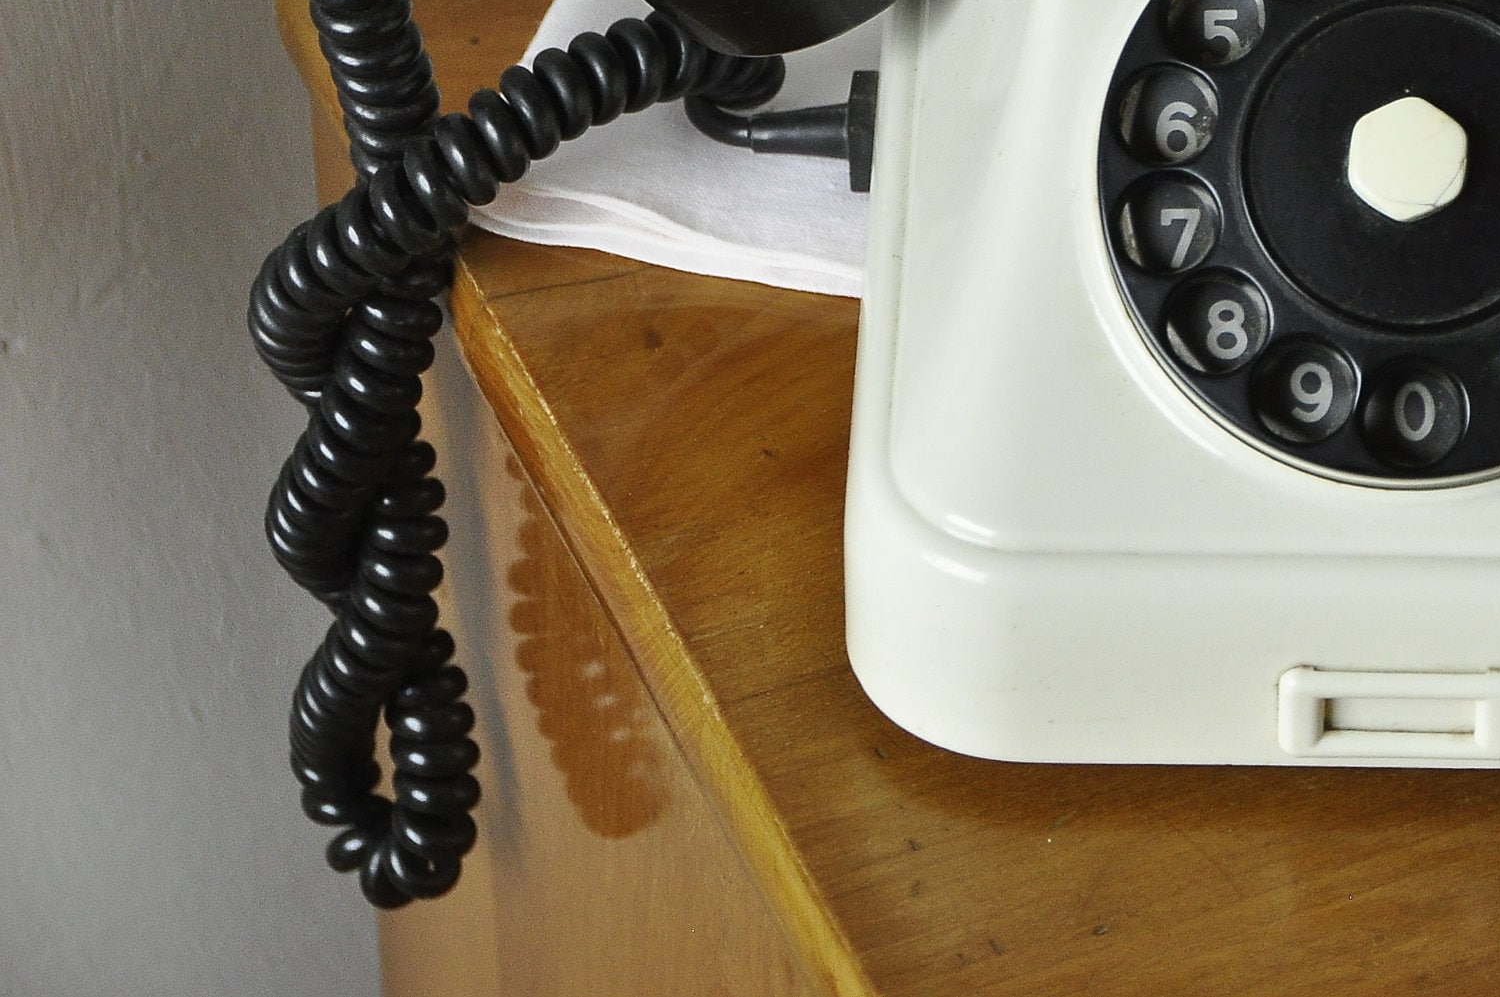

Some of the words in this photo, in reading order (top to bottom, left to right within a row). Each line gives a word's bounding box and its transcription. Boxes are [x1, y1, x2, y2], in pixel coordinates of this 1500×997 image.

[1203, 9, 1239, 60] 5
[1155, 101, 1197, 162] 6
[1160, 208, 1200, 268] 7
[1207, 300, 1248, 360] 8
[1290, 362, 1333, 423] 9
[1394, 382, 1435, 442] 0
